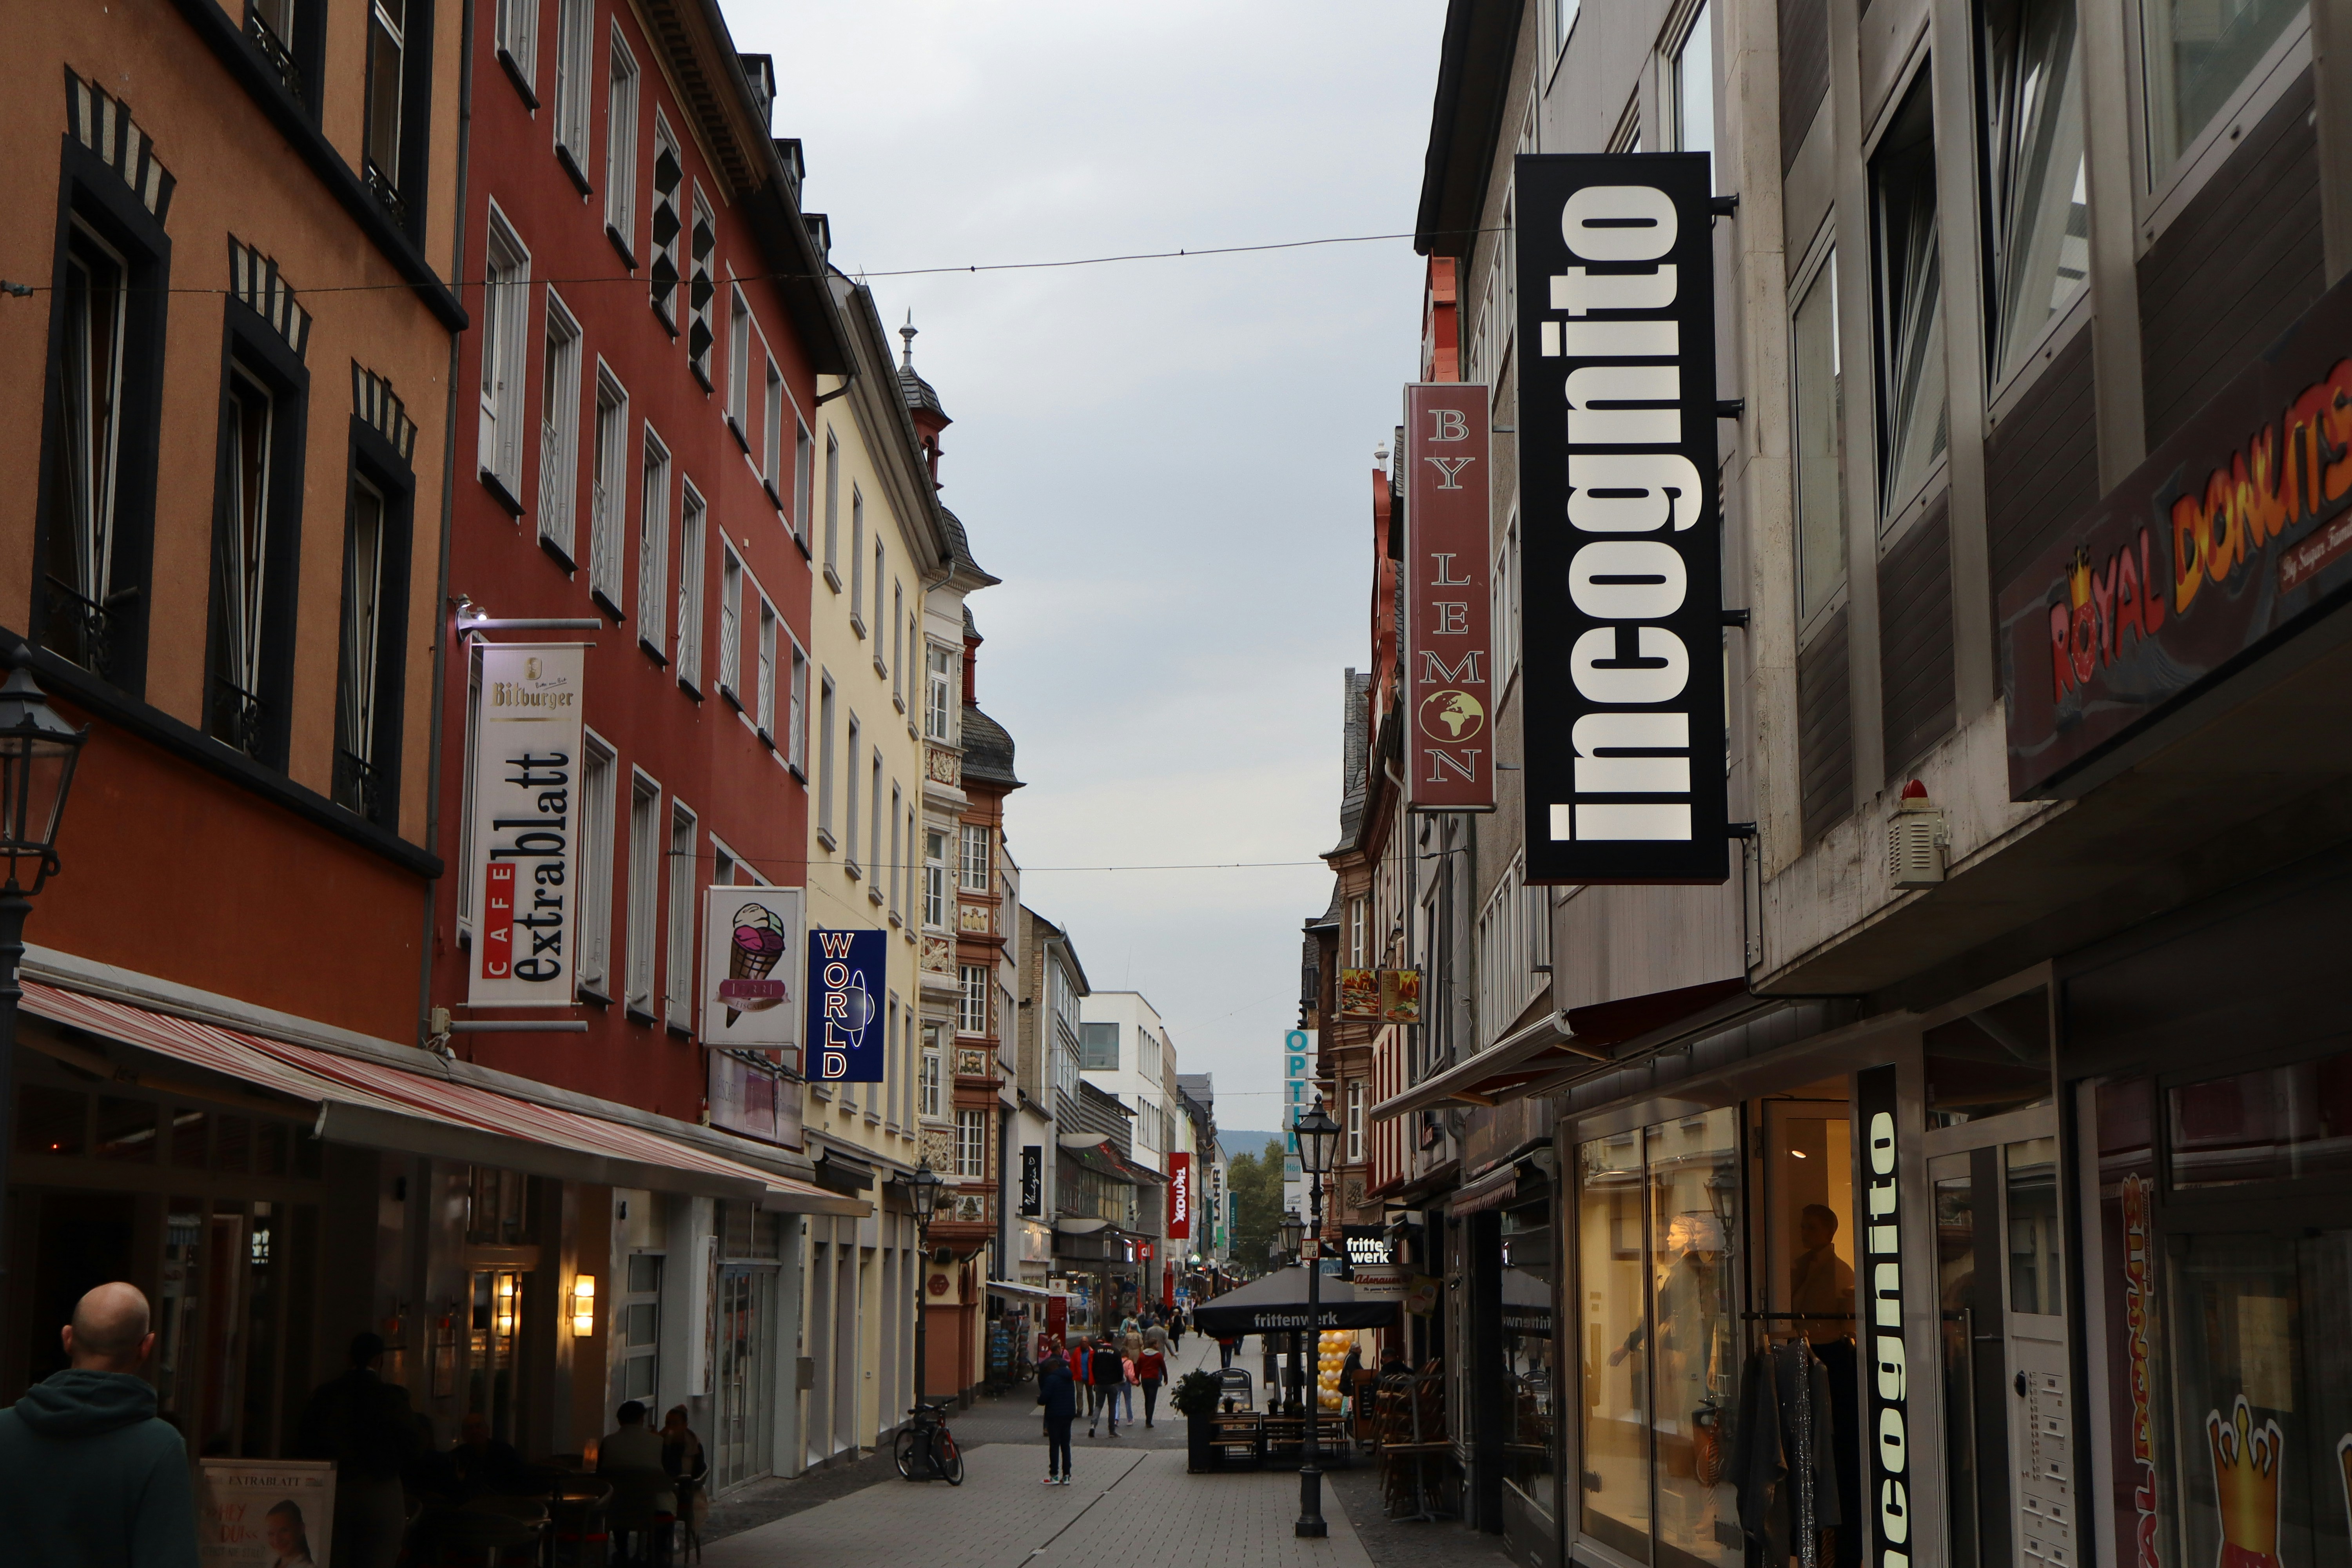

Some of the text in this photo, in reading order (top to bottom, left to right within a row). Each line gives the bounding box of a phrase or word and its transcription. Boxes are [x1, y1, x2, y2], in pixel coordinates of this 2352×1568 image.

[1425, 409, 1476, 489] BY
[1541, 186, 1702, 841] incognito
[2050, 359, 2352, 704] ROYAL DONUTS
[491, 682, 574, 710] Bitburger
[490, 752, 570, 982] extrablatt
[490, 867, 511, 976] CAFE
[819, 933, 855, 1078] WORLD
[1286, 1163, 1301, 1173] Hör
[1346, 1237, 1393, 1252] fritte
[1350, 1248, 1389, 1263] werk
[2122, 1172, 2154, 1464] DONUTS
[219, 1503, 247, 1522] HEY
[229, 1476, 300, 1487] EXTRABLATT
